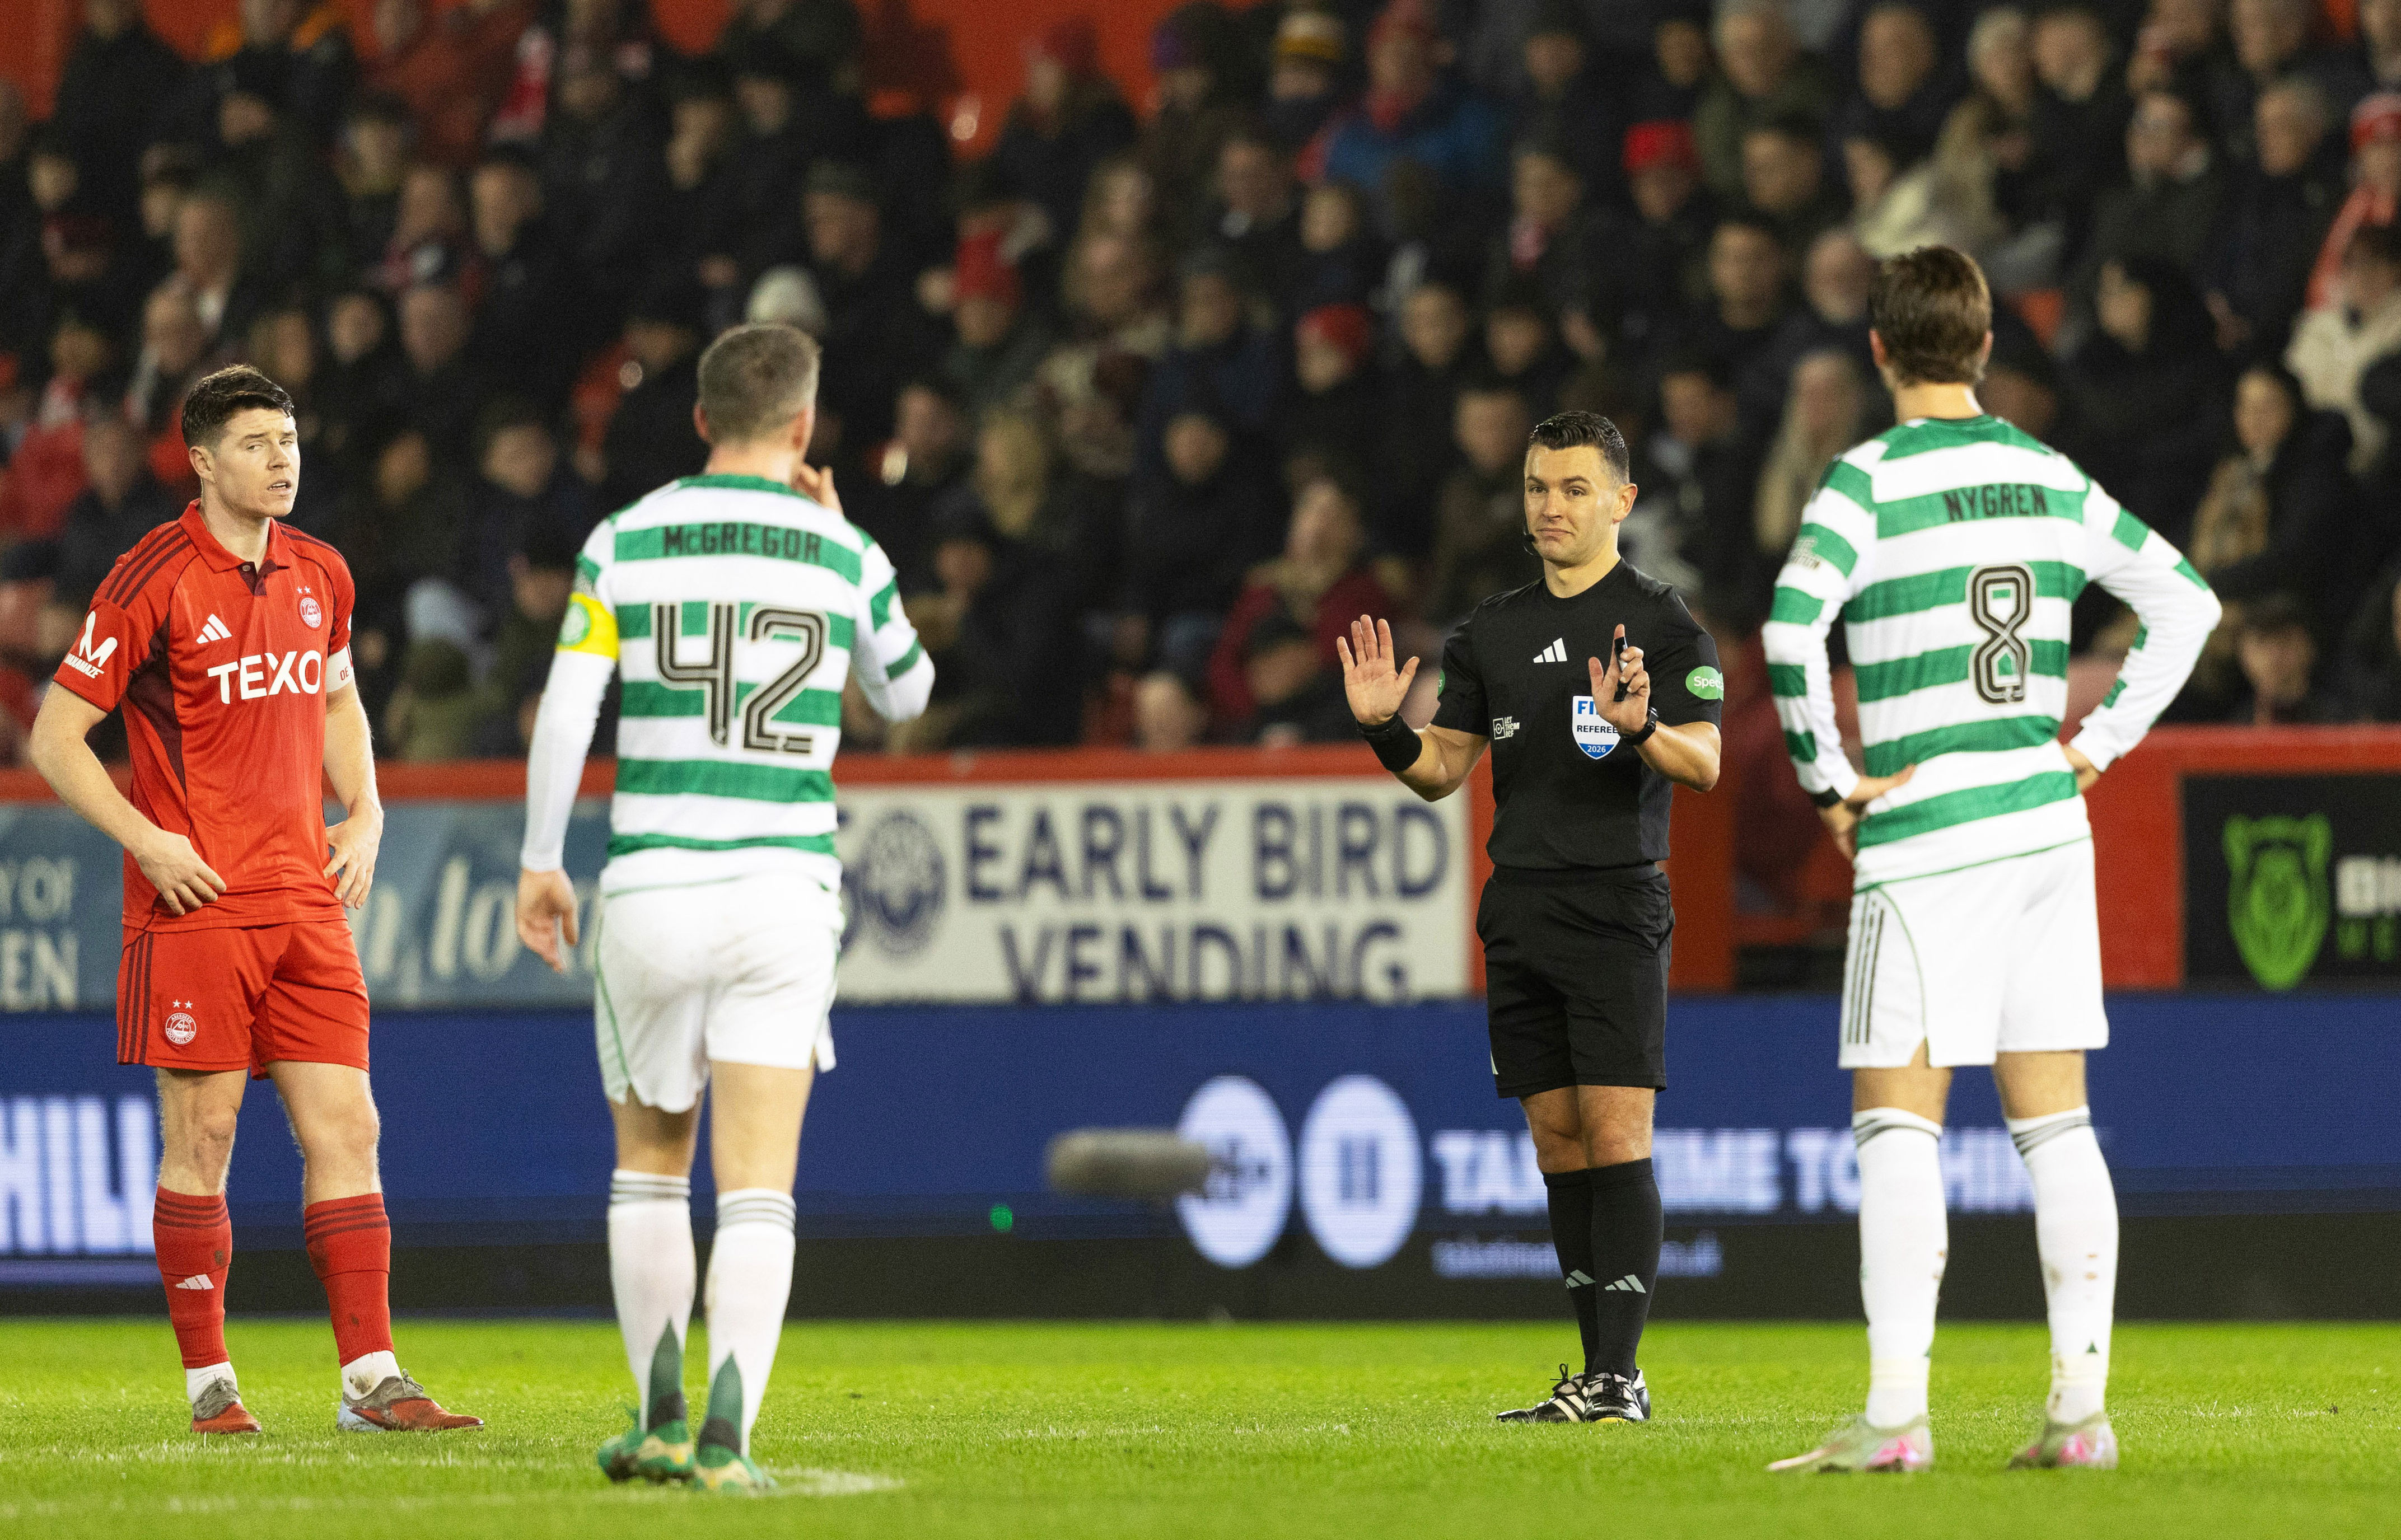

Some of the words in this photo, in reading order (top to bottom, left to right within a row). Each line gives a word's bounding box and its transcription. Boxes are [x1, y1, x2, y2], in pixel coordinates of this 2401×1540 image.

[1942, 483, 2048, 522] NYGREN
[662, 522, 821, 562] McGREGOR
[1970, 565, 2032, 705] 8
[207, 650, 322, 704] TEXO
[654, 602, 825, 755] 42
[1577, 725, 1618, 733] REFEREE
[963, 802, 1221, 901] EARLY
[1252, 801, 1451, 900] BIRD
[999, 917, 1412, 1002] VENDING
